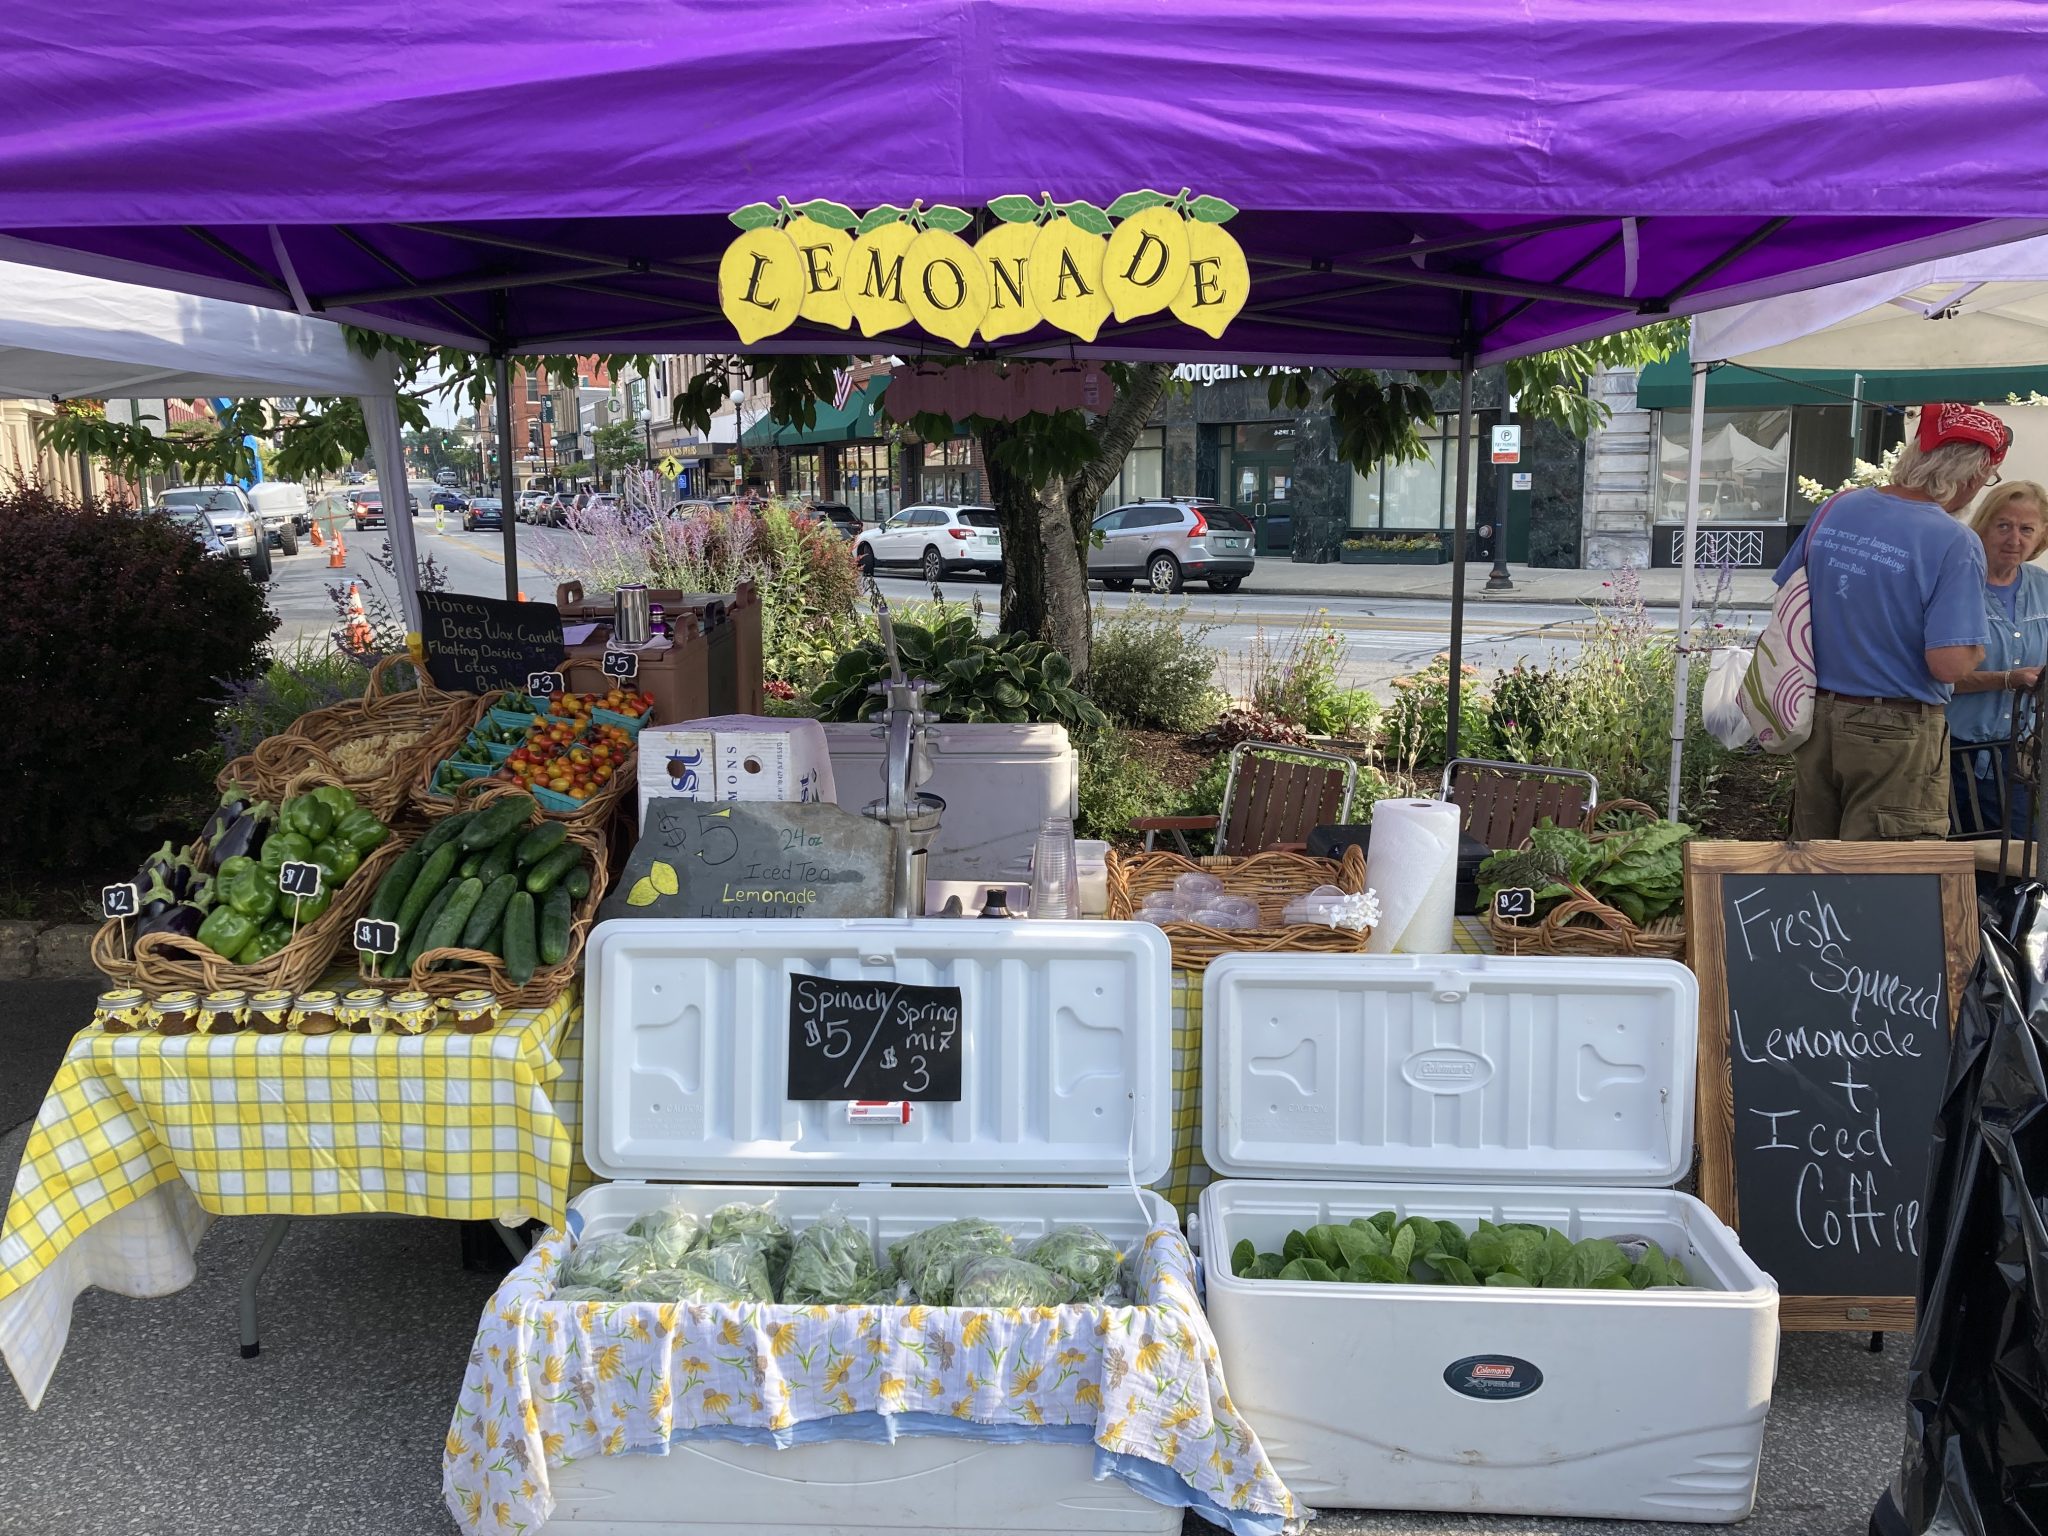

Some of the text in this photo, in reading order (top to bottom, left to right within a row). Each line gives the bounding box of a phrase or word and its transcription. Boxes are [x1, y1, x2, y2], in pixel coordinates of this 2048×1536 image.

[738, 228, 1229, 312] LEMONADE
[424, 595, 489, 622] Honey
[442, 617, 482, 640] Bees
[483, 622, 513, 641] Wax
[428, 641, 478, 663] Floating
[481, 644, 523, 660] Daisies
[606, 655, 629, 673] $5
[455, 658, 498, 674] Lotus
[531, 675, 554, 692] $3
[658, 807, 740, 866] $5
[781, 827, 823, 850] 24 oz
[744, 862, 831, 882] Iced Tea
[722, 883, 817, 904] Lemonade
[1500, 892, 1523, 911] $2
[701, 905, 741, 918] Hlf
[764, 905, 805, 918] Hlf
[359, 925, 380, 948] $1
[1733, 888, 1851, 962] Fresh
[1810, 943, 1942, 1029] Squeezed
[896, 1001, 958, 1035] Spring
[805, 1018, 852, 1058] $5
[906, 1026, 953, 1053] mix
[1733, 1010, 1922, 1063] Lemonade
[1749, 1108, 1893, 1166] Iced
